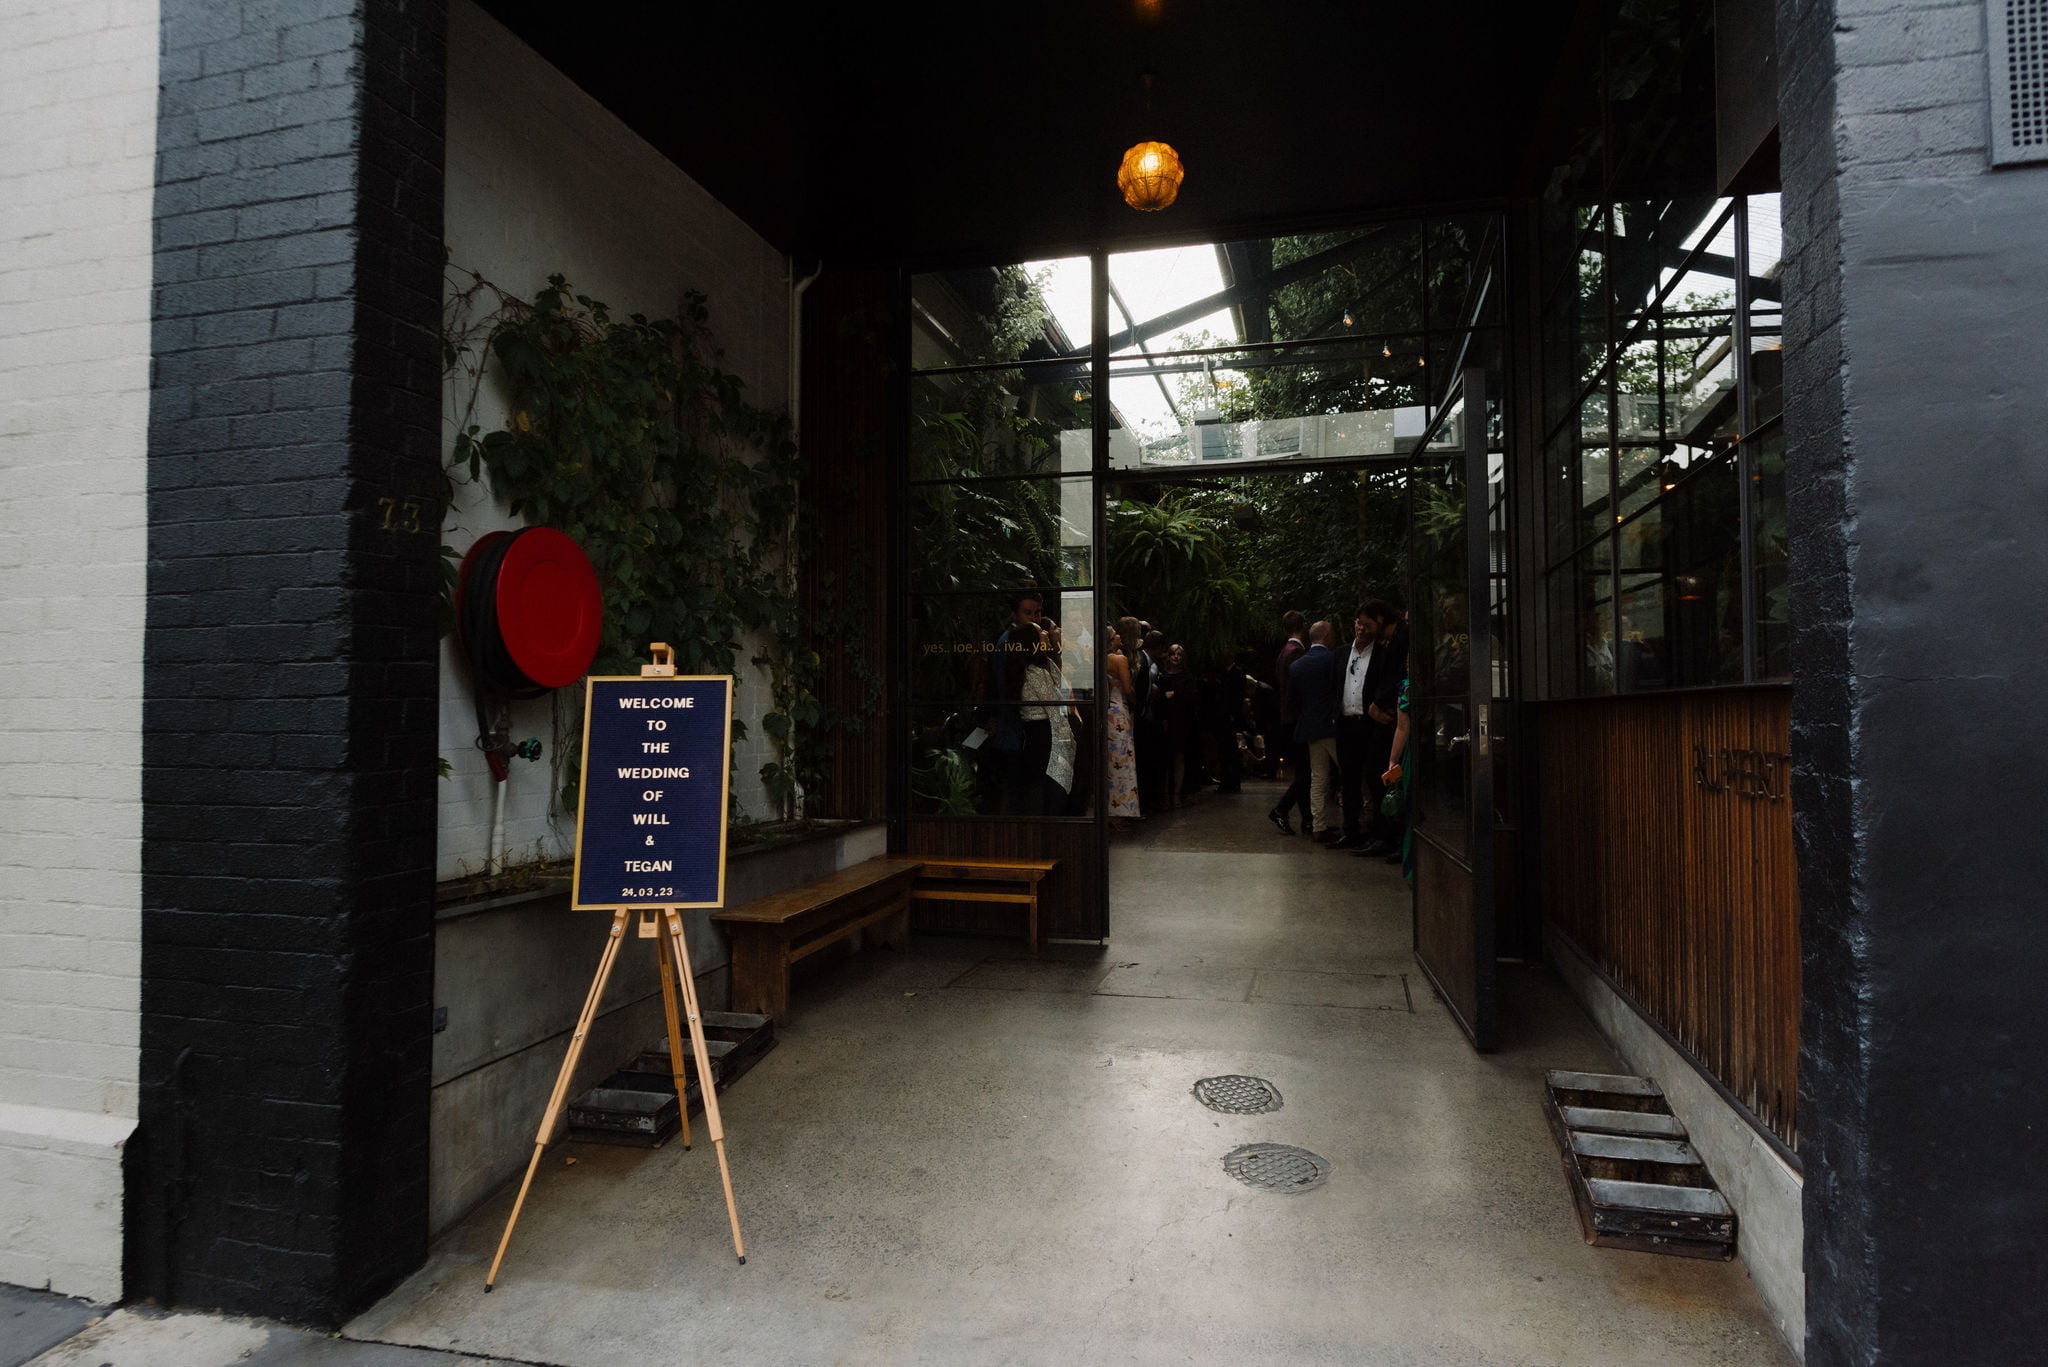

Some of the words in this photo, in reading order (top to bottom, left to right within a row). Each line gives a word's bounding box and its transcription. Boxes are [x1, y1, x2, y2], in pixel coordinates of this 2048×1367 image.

[619, 697, 695, 709] WELCOME
[646, 720, 667, 731] TO
[641, 742, 670, 754] THE
[618, 767, 690, 779] WEDDING
[642, 790, 664, 802] OF
[633, 813, 670, 825] WILL
[645, 835, 655, 846] &
[624, 860, 673, 873] TEGAN
[622, 887, 673, 898] 24.03.23
